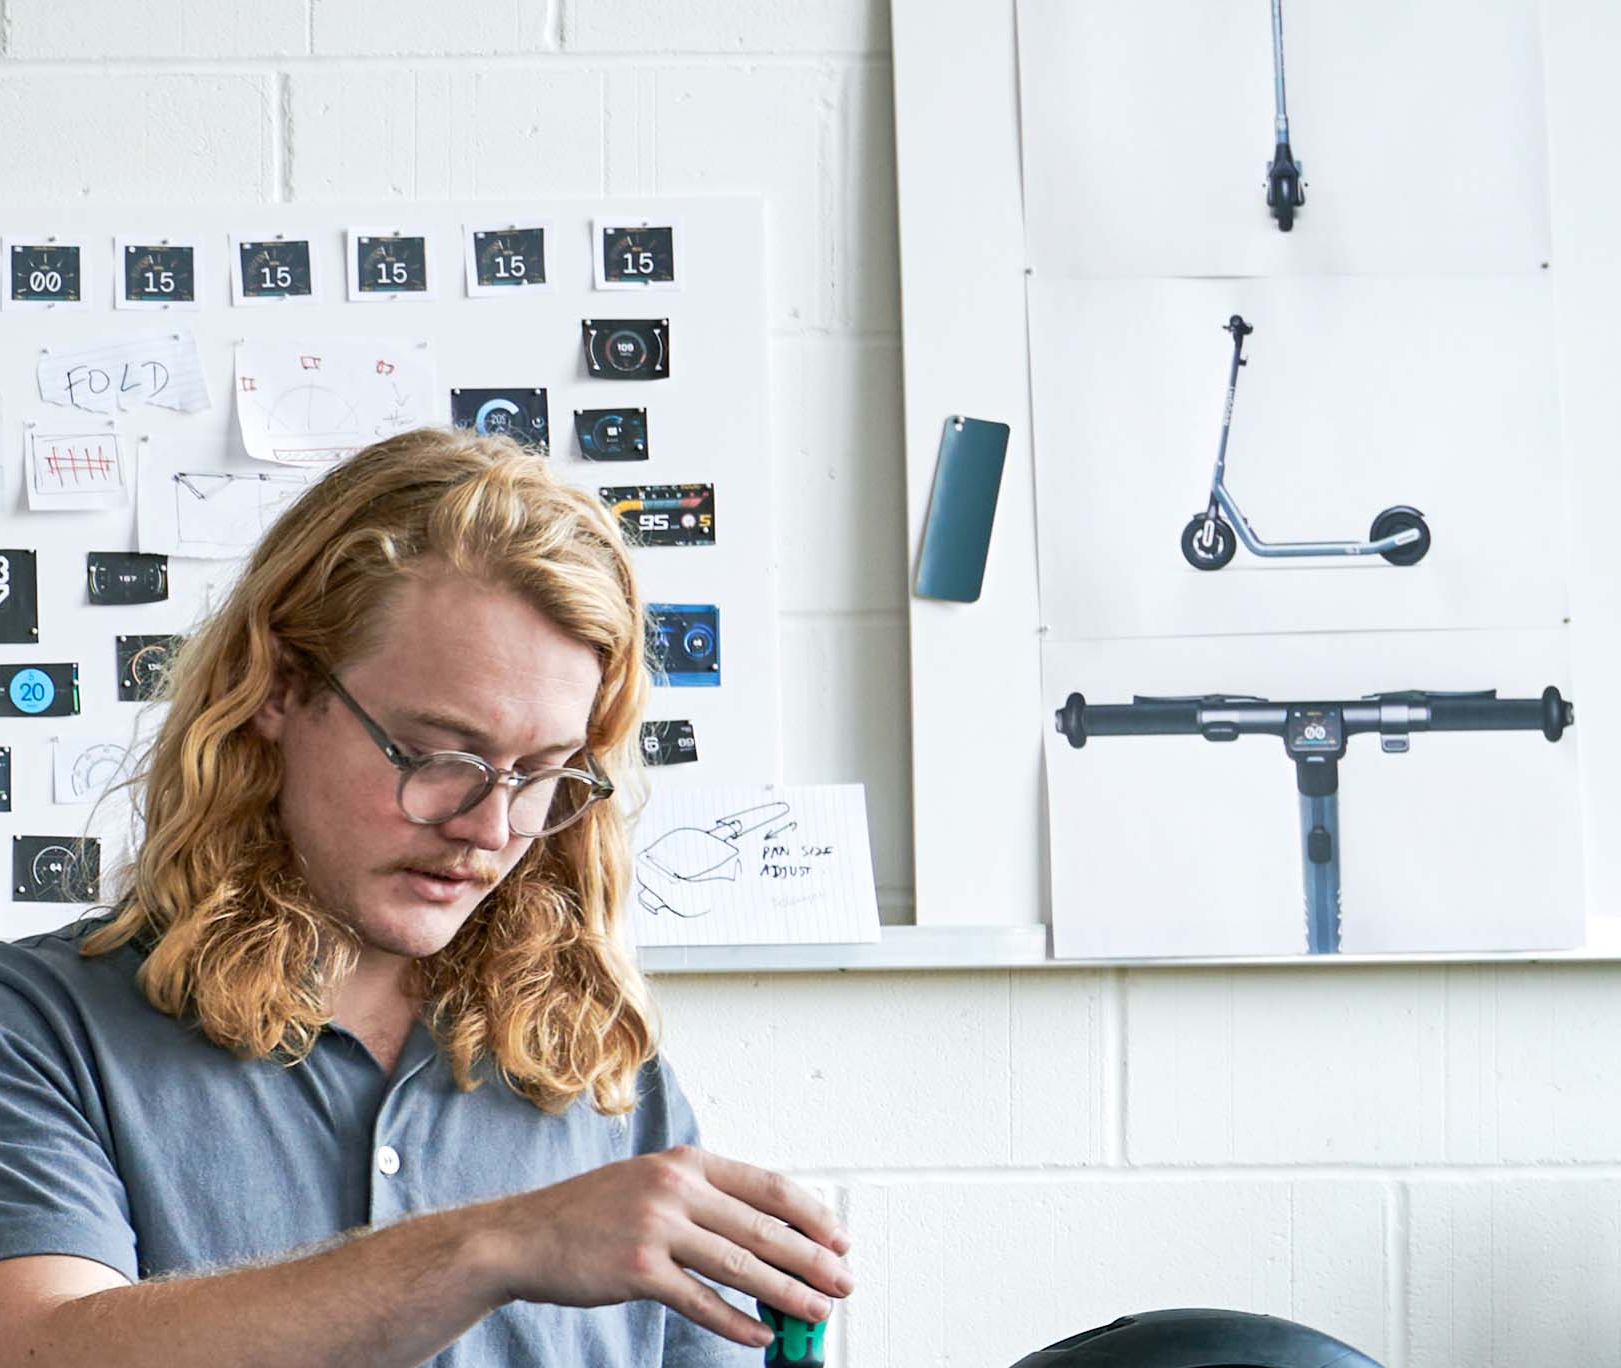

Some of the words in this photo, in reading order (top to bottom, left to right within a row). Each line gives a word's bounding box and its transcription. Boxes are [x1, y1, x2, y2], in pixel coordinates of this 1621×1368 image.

[376, 262, 409, 284] 15
[494, 255, 527, 278] 15
[622, 252, 656, 275] 15
[29, 271, 62, 293] 00
[143, 271, 176, 293] 15
[260, 266, 293, 289] 15
[64, 361, 170, 405] FOLD
[639, 513, 670, 531] 95
[19, 682, 45, 702] 20
[762, 845, 790, 861] PAN
[760, 863, 813, 880] ADJUST
